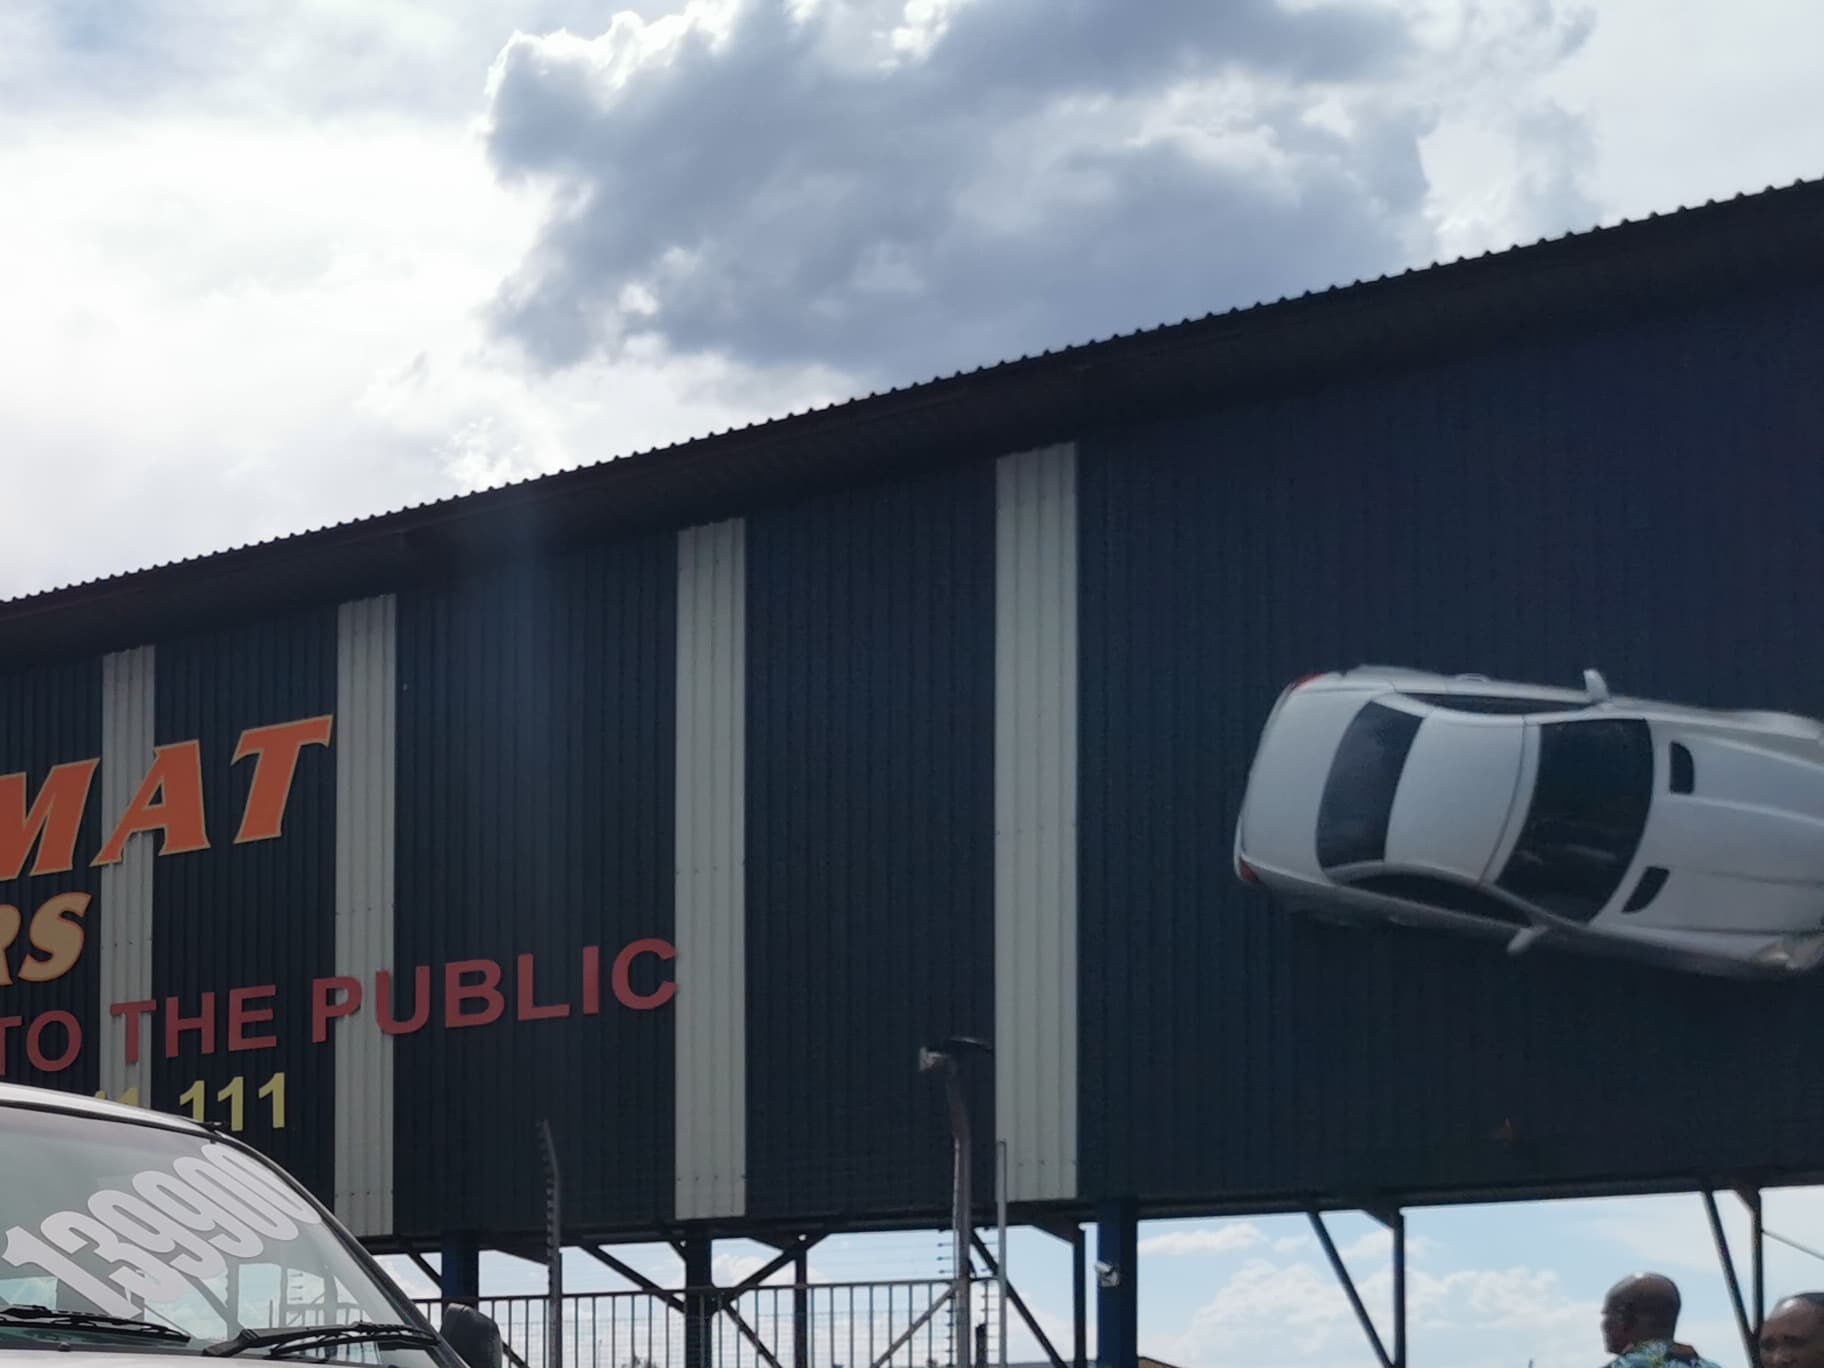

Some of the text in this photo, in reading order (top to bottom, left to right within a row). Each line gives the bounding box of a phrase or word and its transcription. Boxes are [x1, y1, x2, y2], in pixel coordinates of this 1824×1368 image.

[110, 984, 277, 1064] THE
[311, 937, 677, 1043] PUBLIC
[179, 1072, 285, 1132] 111
[1, 1143, 323, 1320] 139900
